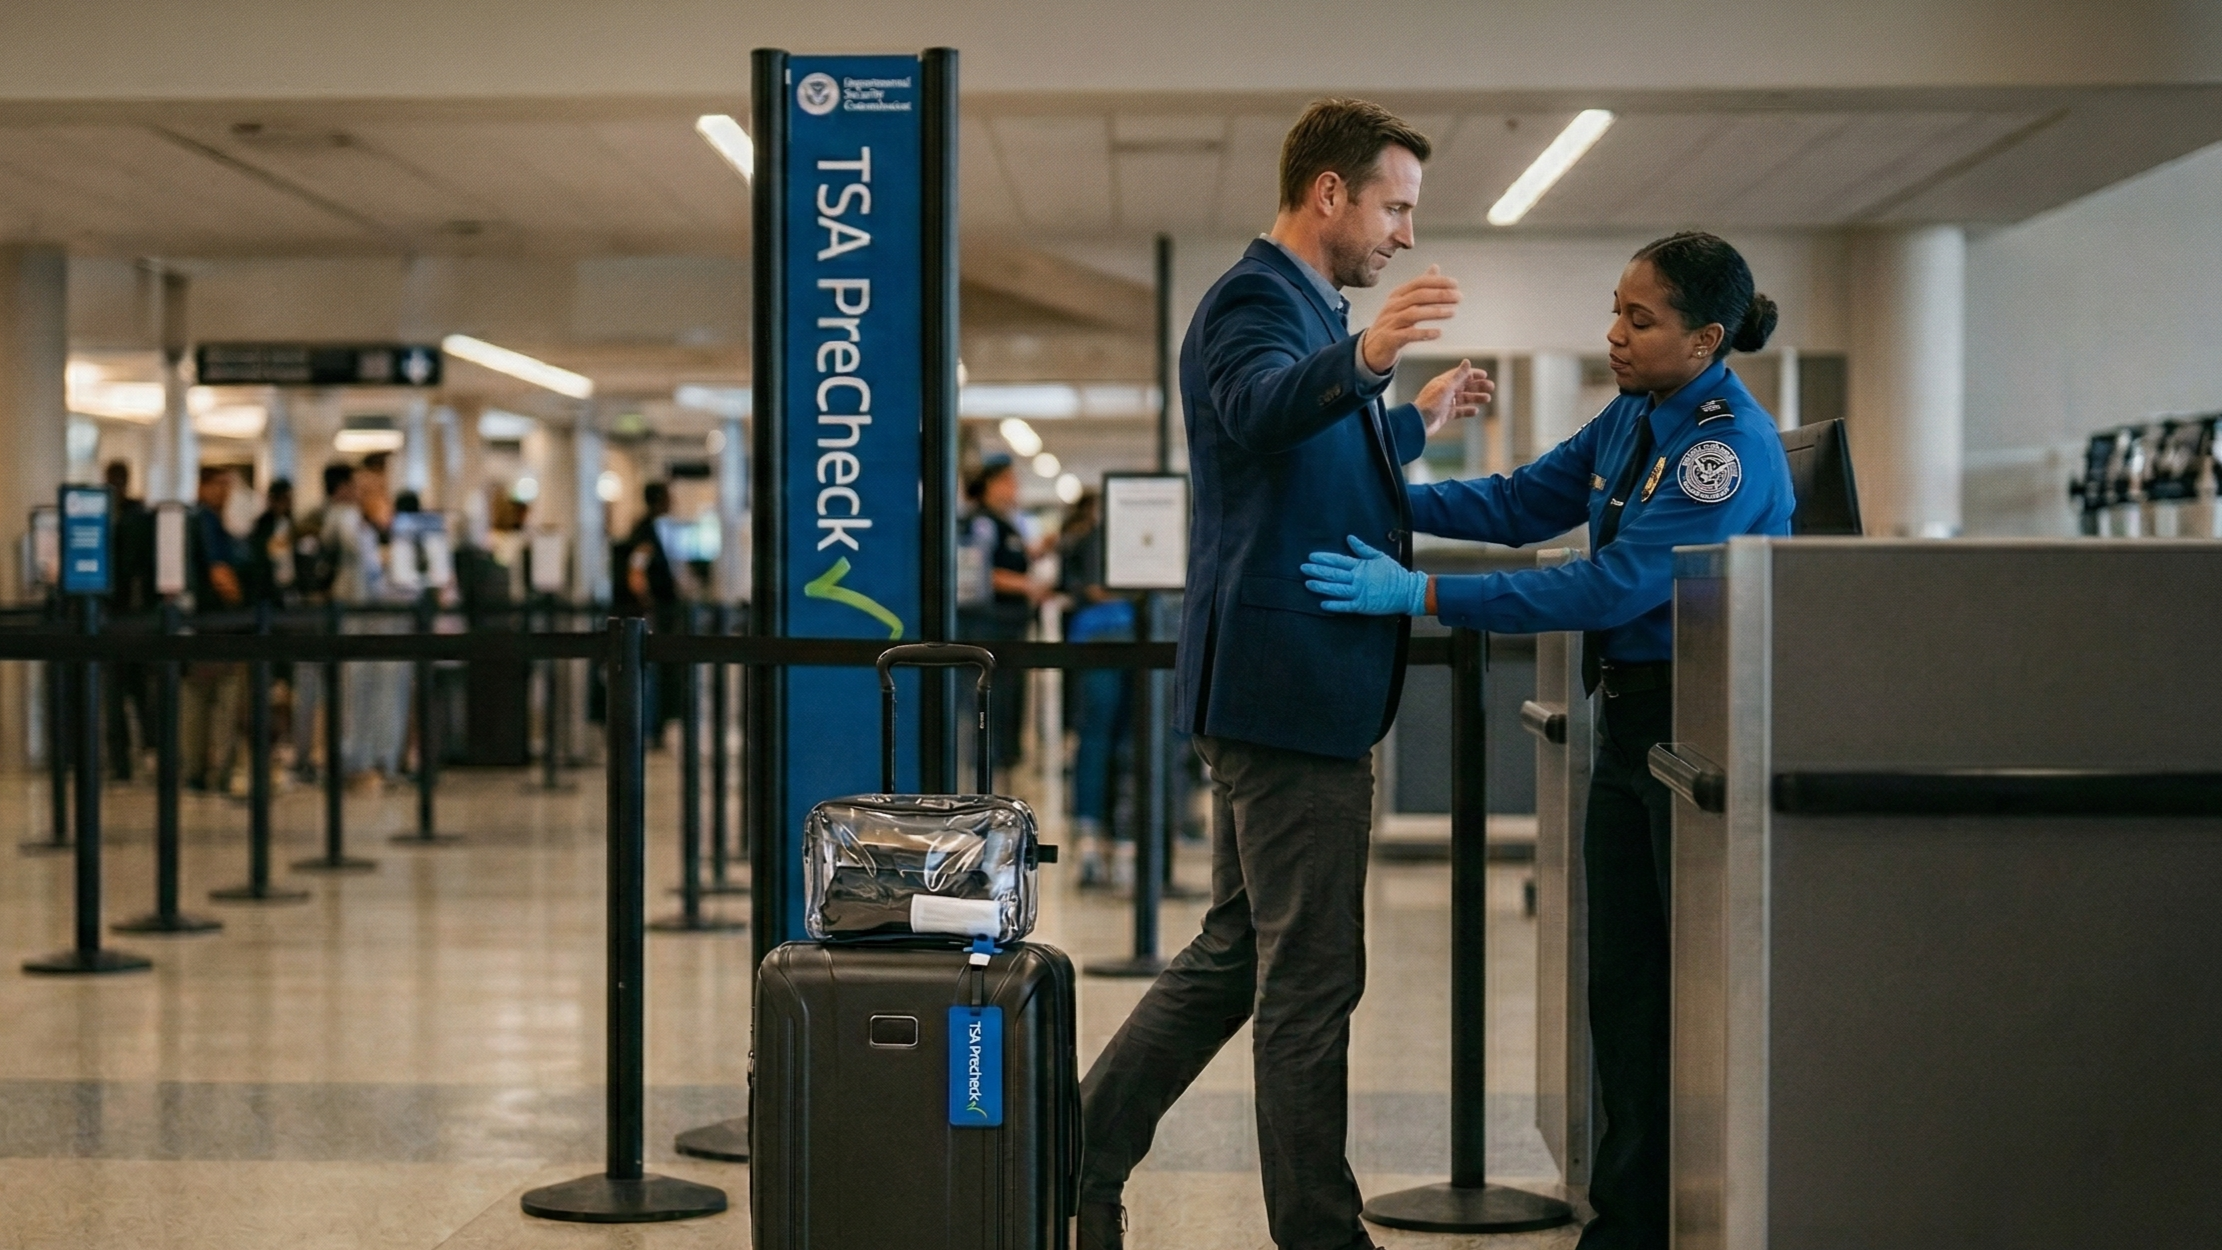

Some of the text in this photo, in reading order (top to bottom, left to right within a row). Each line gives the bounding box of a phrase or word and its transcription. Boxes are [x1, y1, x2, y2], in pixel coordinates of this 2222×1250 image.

[816, 146, 873, 551] TSA PreCheck
[969, 1020, 982, 1044] TSA
